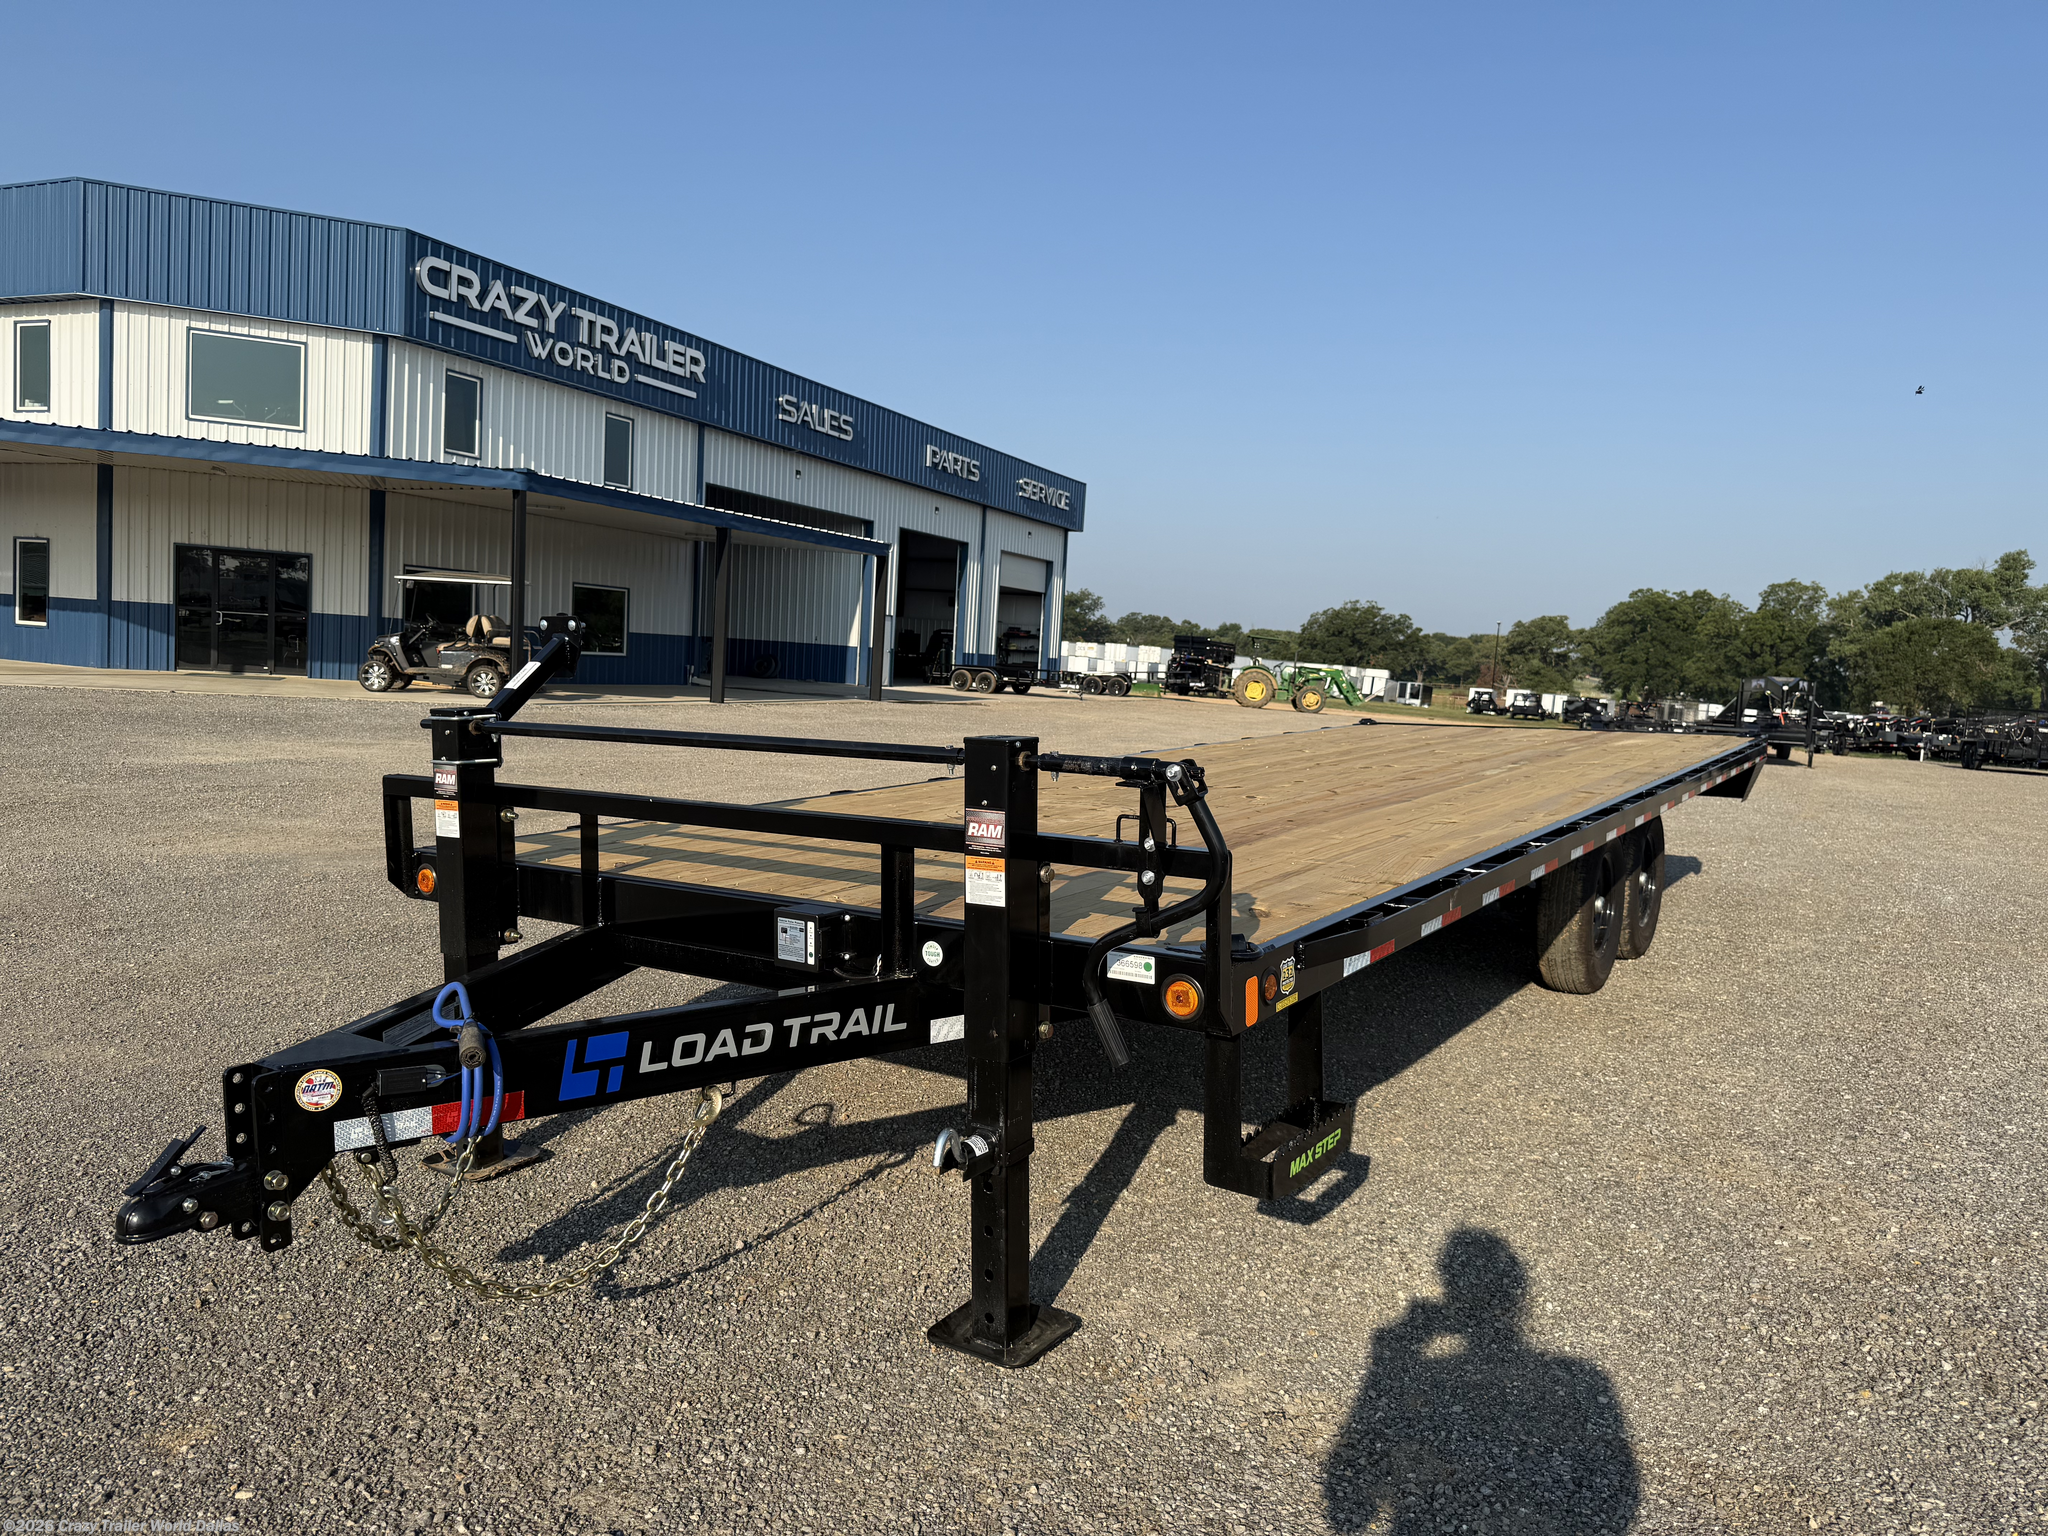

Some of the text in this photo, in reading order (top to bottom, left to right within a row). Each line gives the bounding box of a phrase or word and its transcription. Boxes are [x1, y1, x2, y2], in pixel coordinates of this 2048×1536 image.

[415, 256, 706, 383] CRAZY TRAILER
[524, 330, 630, 384] WORLD
[778, 394, 853, 441] SALES
[926, 444, 980, 482] PARTS
[1016, 477, 1070, 511] SERVICE
[435, 773, 455, 785] RAM
[967, 823, 1002, 838] RAM
[1116, 959, 1143, 970] 366598
[639, 1003, 907, 1073] LOAD TRAIL
[302, 1081, 334, 1094] NATM
[1290, 1128, 1341, 1178] MAX STEP
